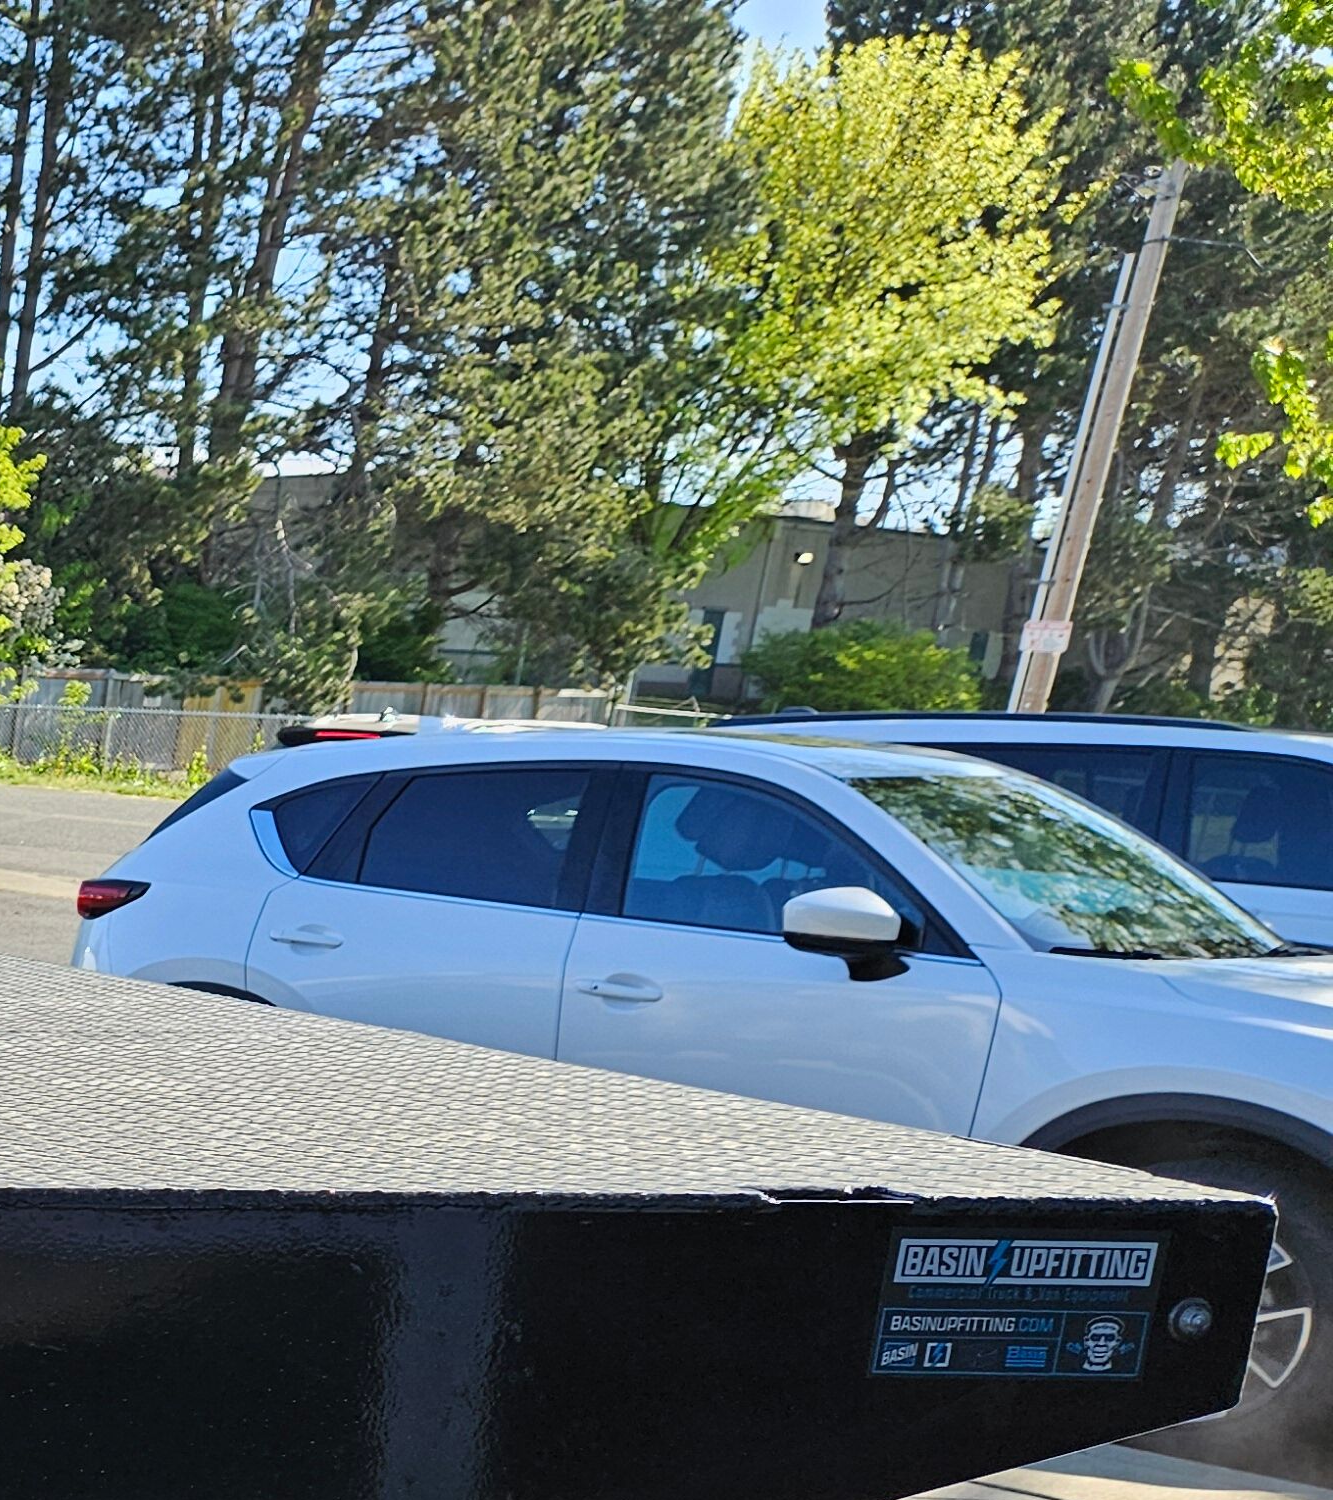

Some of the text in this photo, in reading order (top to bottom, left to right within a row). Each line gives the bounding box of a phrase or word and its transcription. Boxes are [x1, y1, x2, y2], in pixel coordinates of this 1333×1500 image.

[904, 1246, 1148, 1278] BASIN UPFITTING
[890, 1315, 1054, 1332] BASINUPFITTING.COM
[881, 1342, 919, 1366] BASIN
